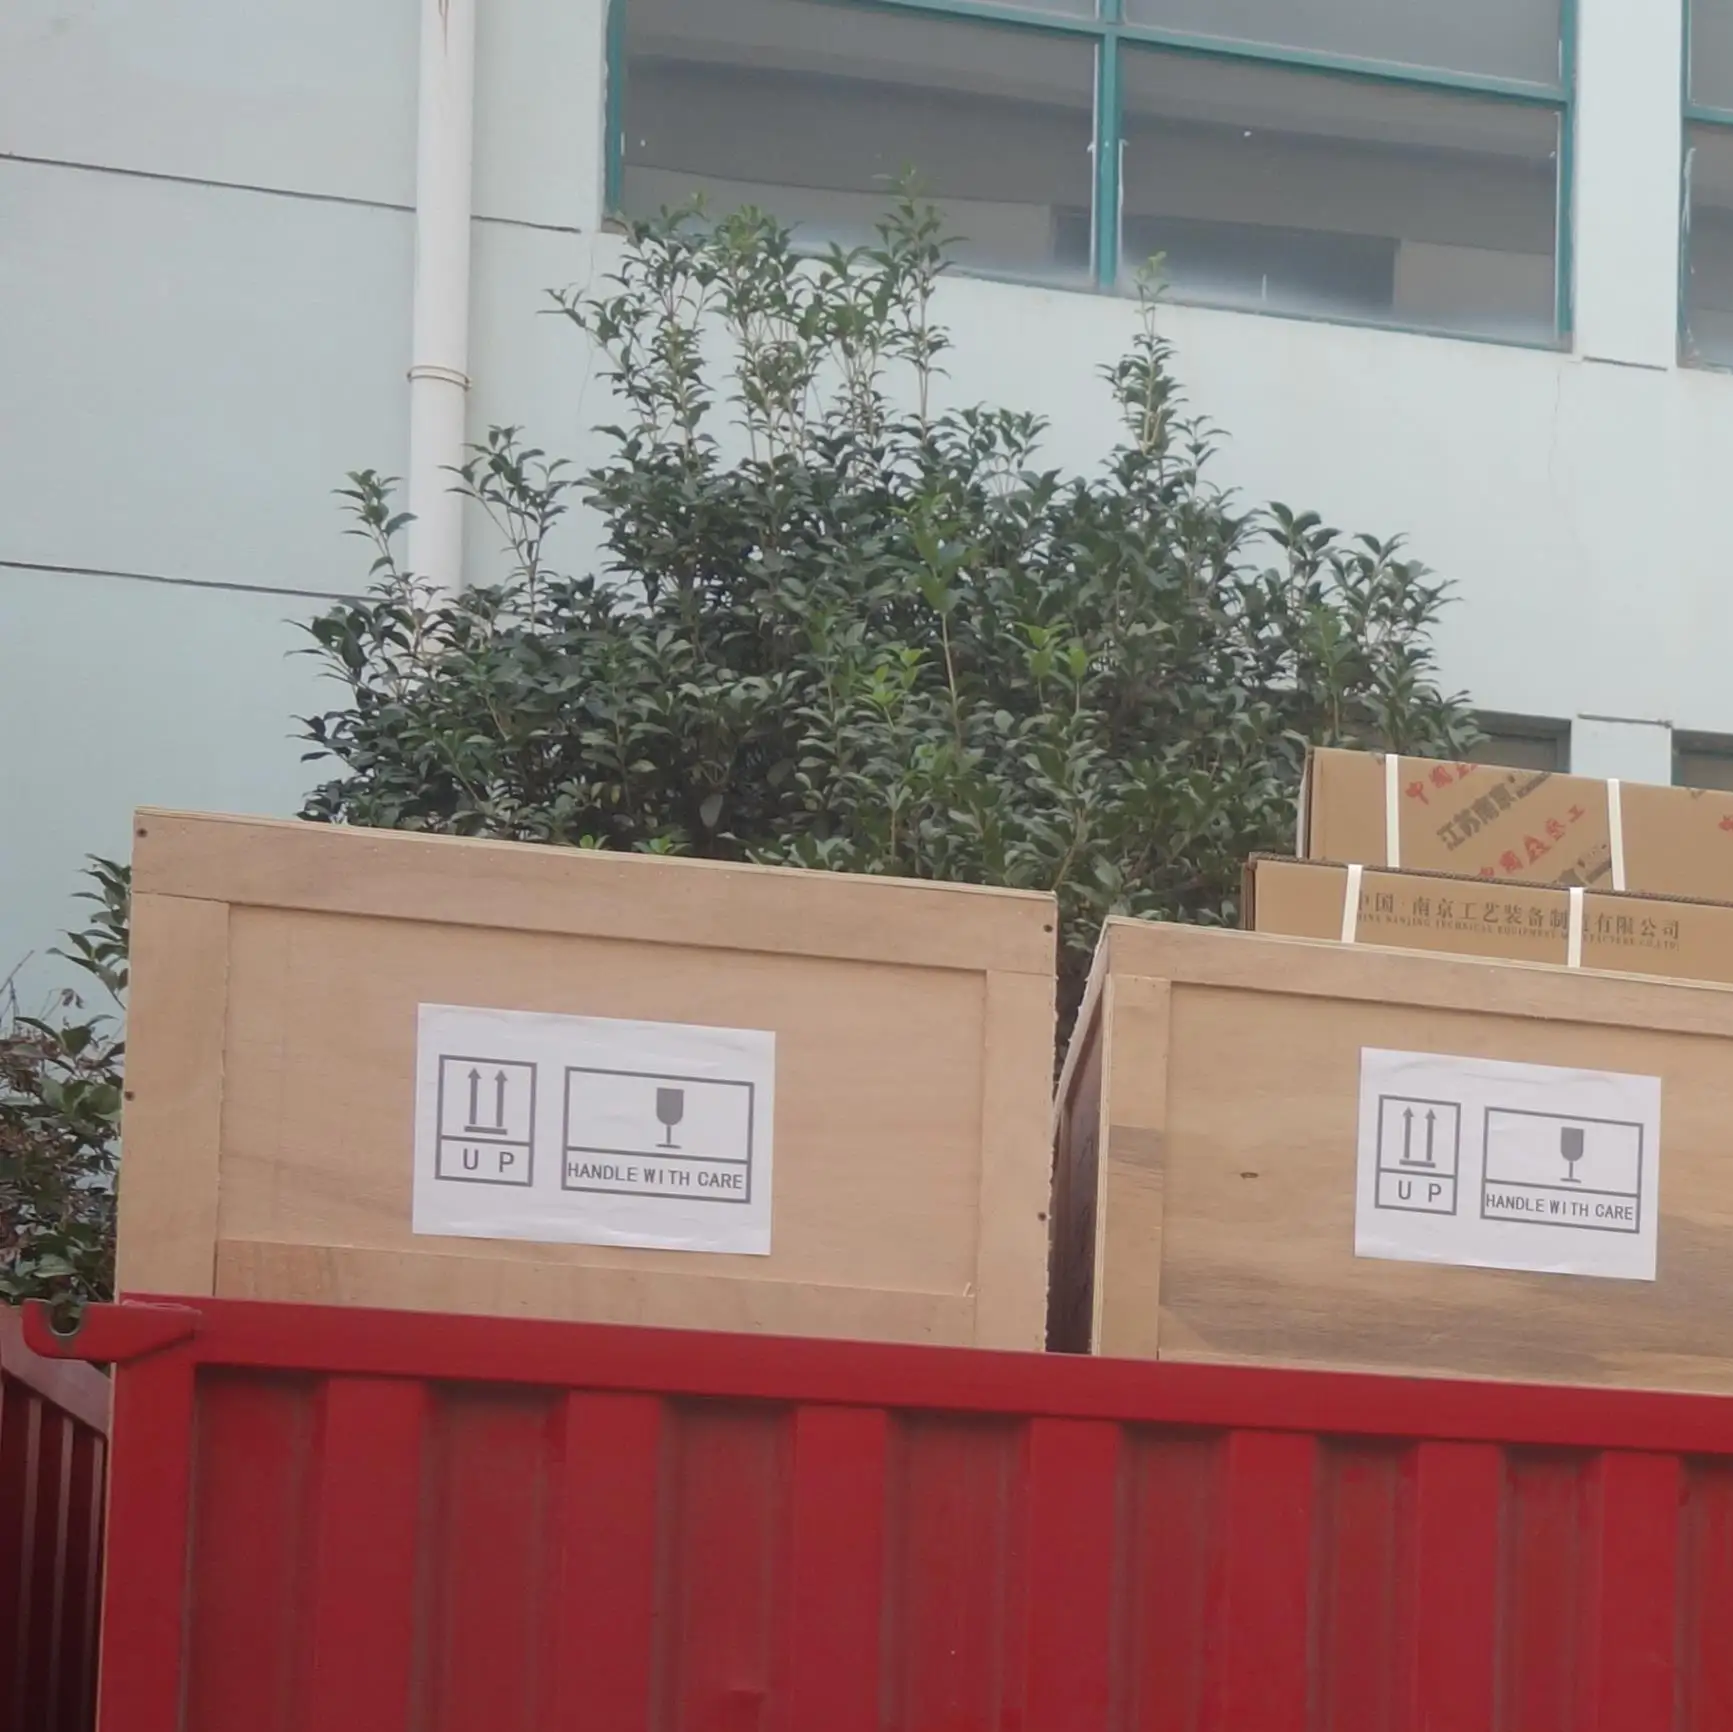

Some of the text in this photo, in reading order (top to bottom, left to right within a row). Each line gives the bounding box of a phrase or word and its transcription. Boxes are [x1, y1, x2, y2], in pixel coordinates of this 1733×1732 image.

[568, 1162, 743, 1190] HANDLE WITH CARE
[1485, 1193, 1633, 1221] HANDLE WITH CARE
